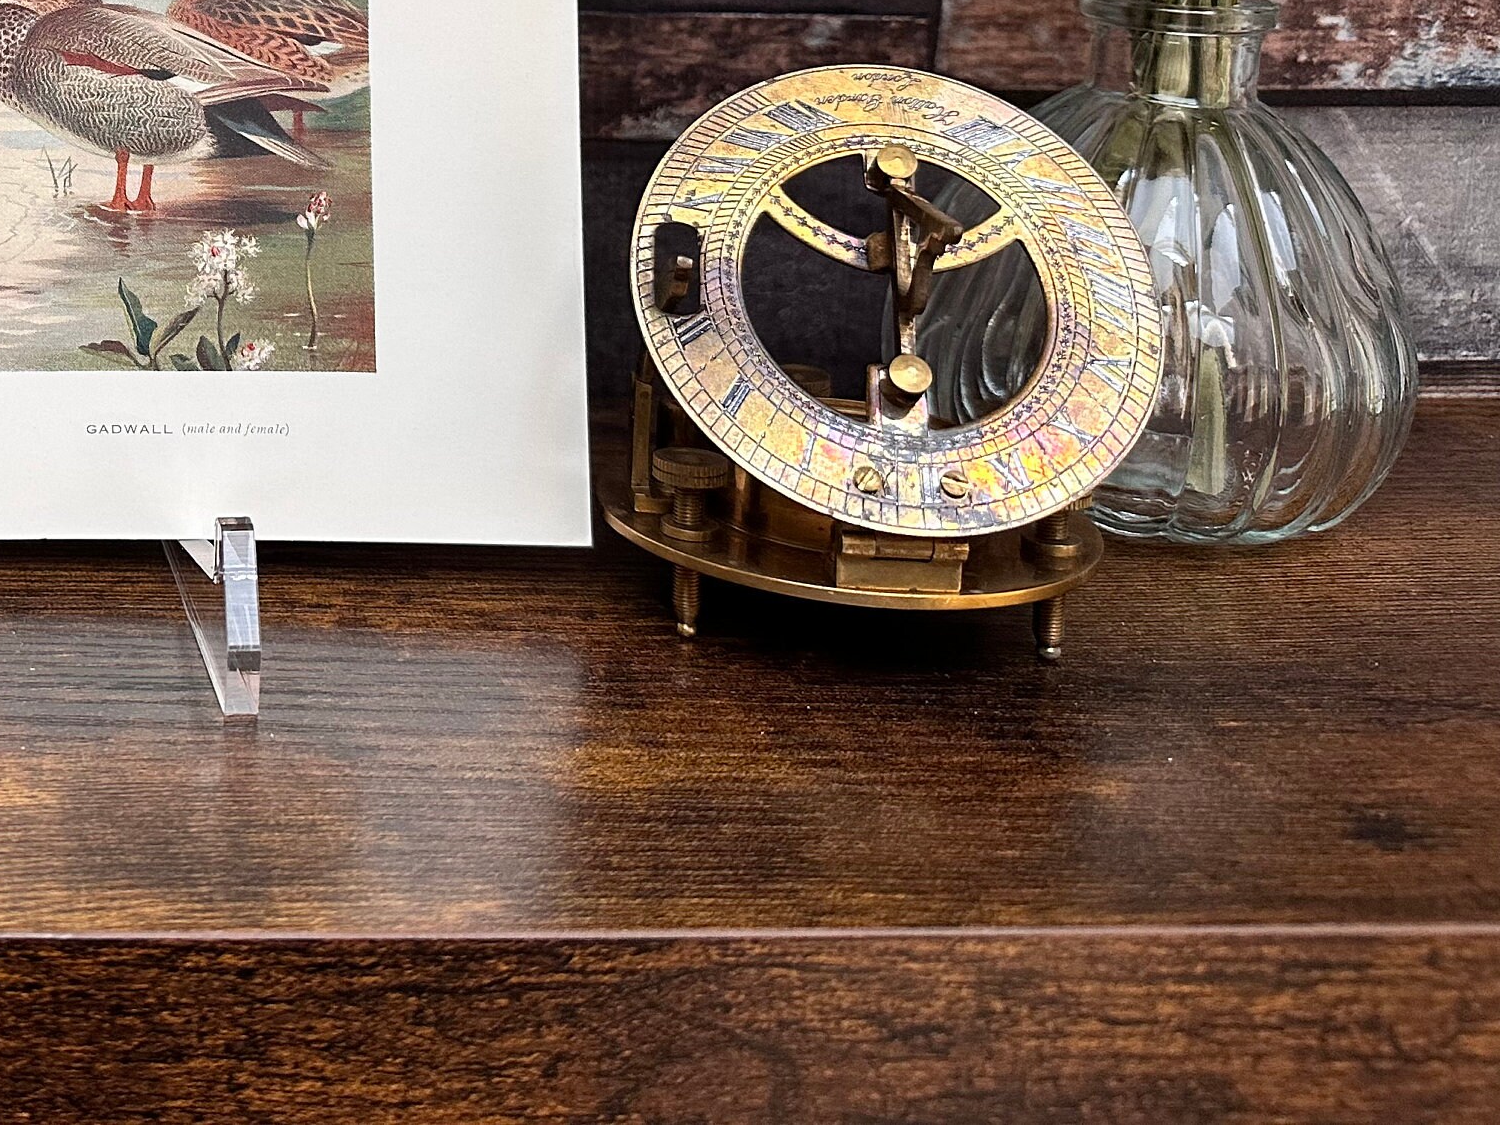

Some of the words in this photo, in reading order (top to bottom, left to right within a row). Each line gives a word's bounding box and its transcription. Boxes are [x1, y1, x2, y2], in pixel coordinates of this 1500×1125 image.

[86, 423, 174, 435] GADWALL
[181, 422, 216, 437] (male
[218, 422, 242, 436] and
[243, 422, 291, 437] female)
